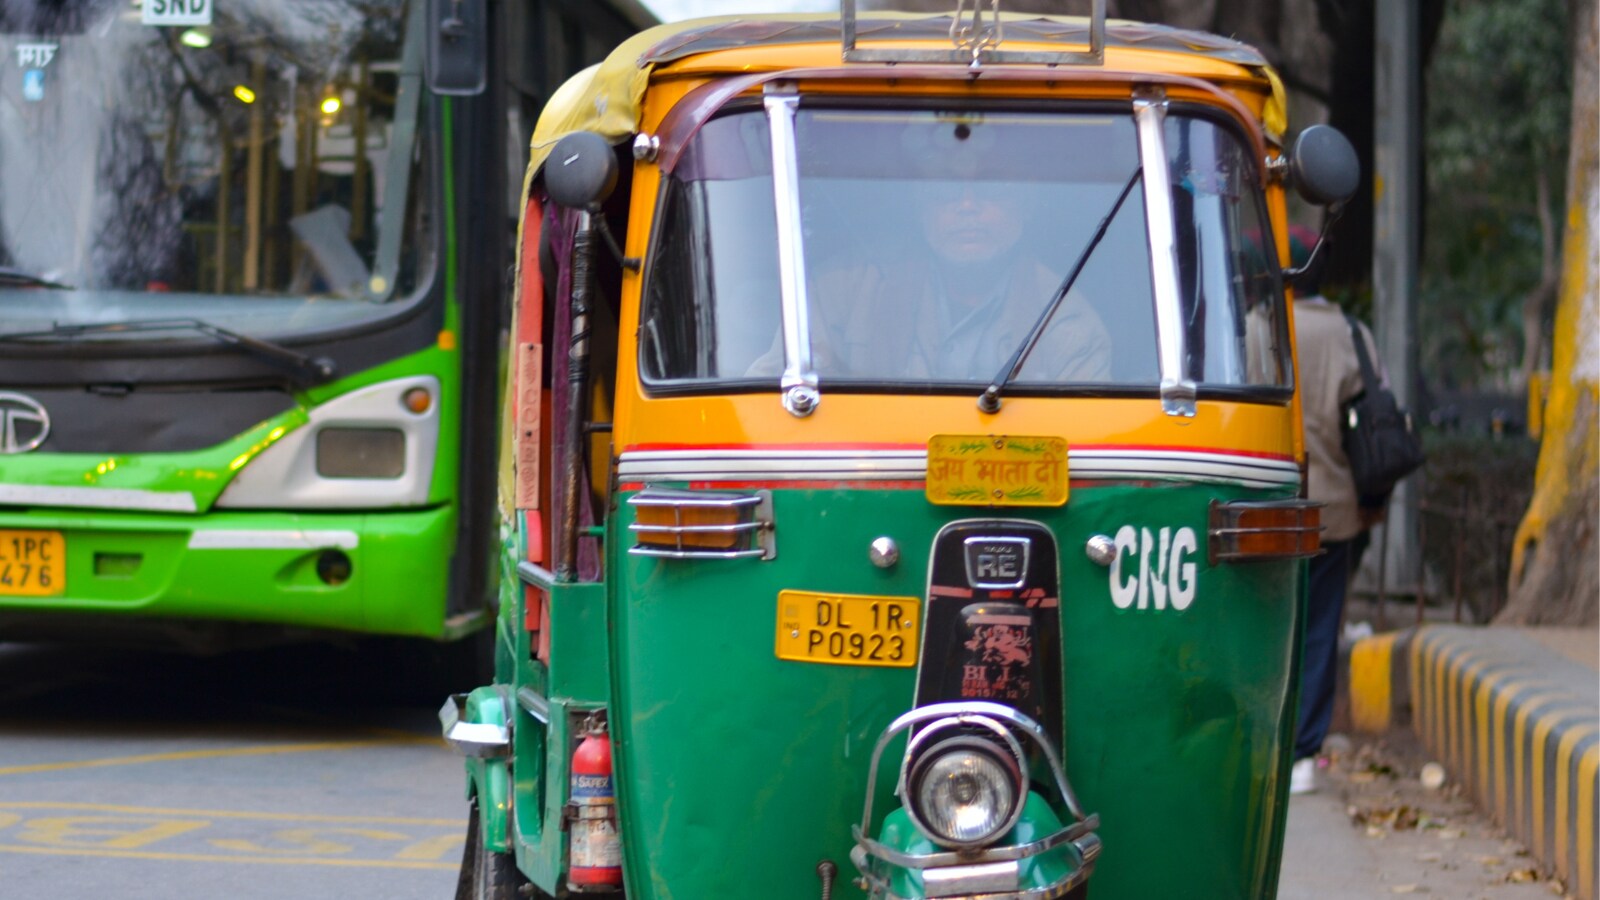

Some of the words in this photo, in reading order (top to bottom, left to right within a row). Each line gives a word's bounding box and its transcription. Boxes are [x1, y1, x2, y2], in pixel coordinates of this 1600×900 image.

[0, 538, 51, 560] 1PC
[977, 554, 1017, 578] RE
[1109, 524, 1198, 611] CNG
[816, 599, 852, 629] DL
[871, 602, 903, 631] 1R
[808, 629, 904, 661] P0923
